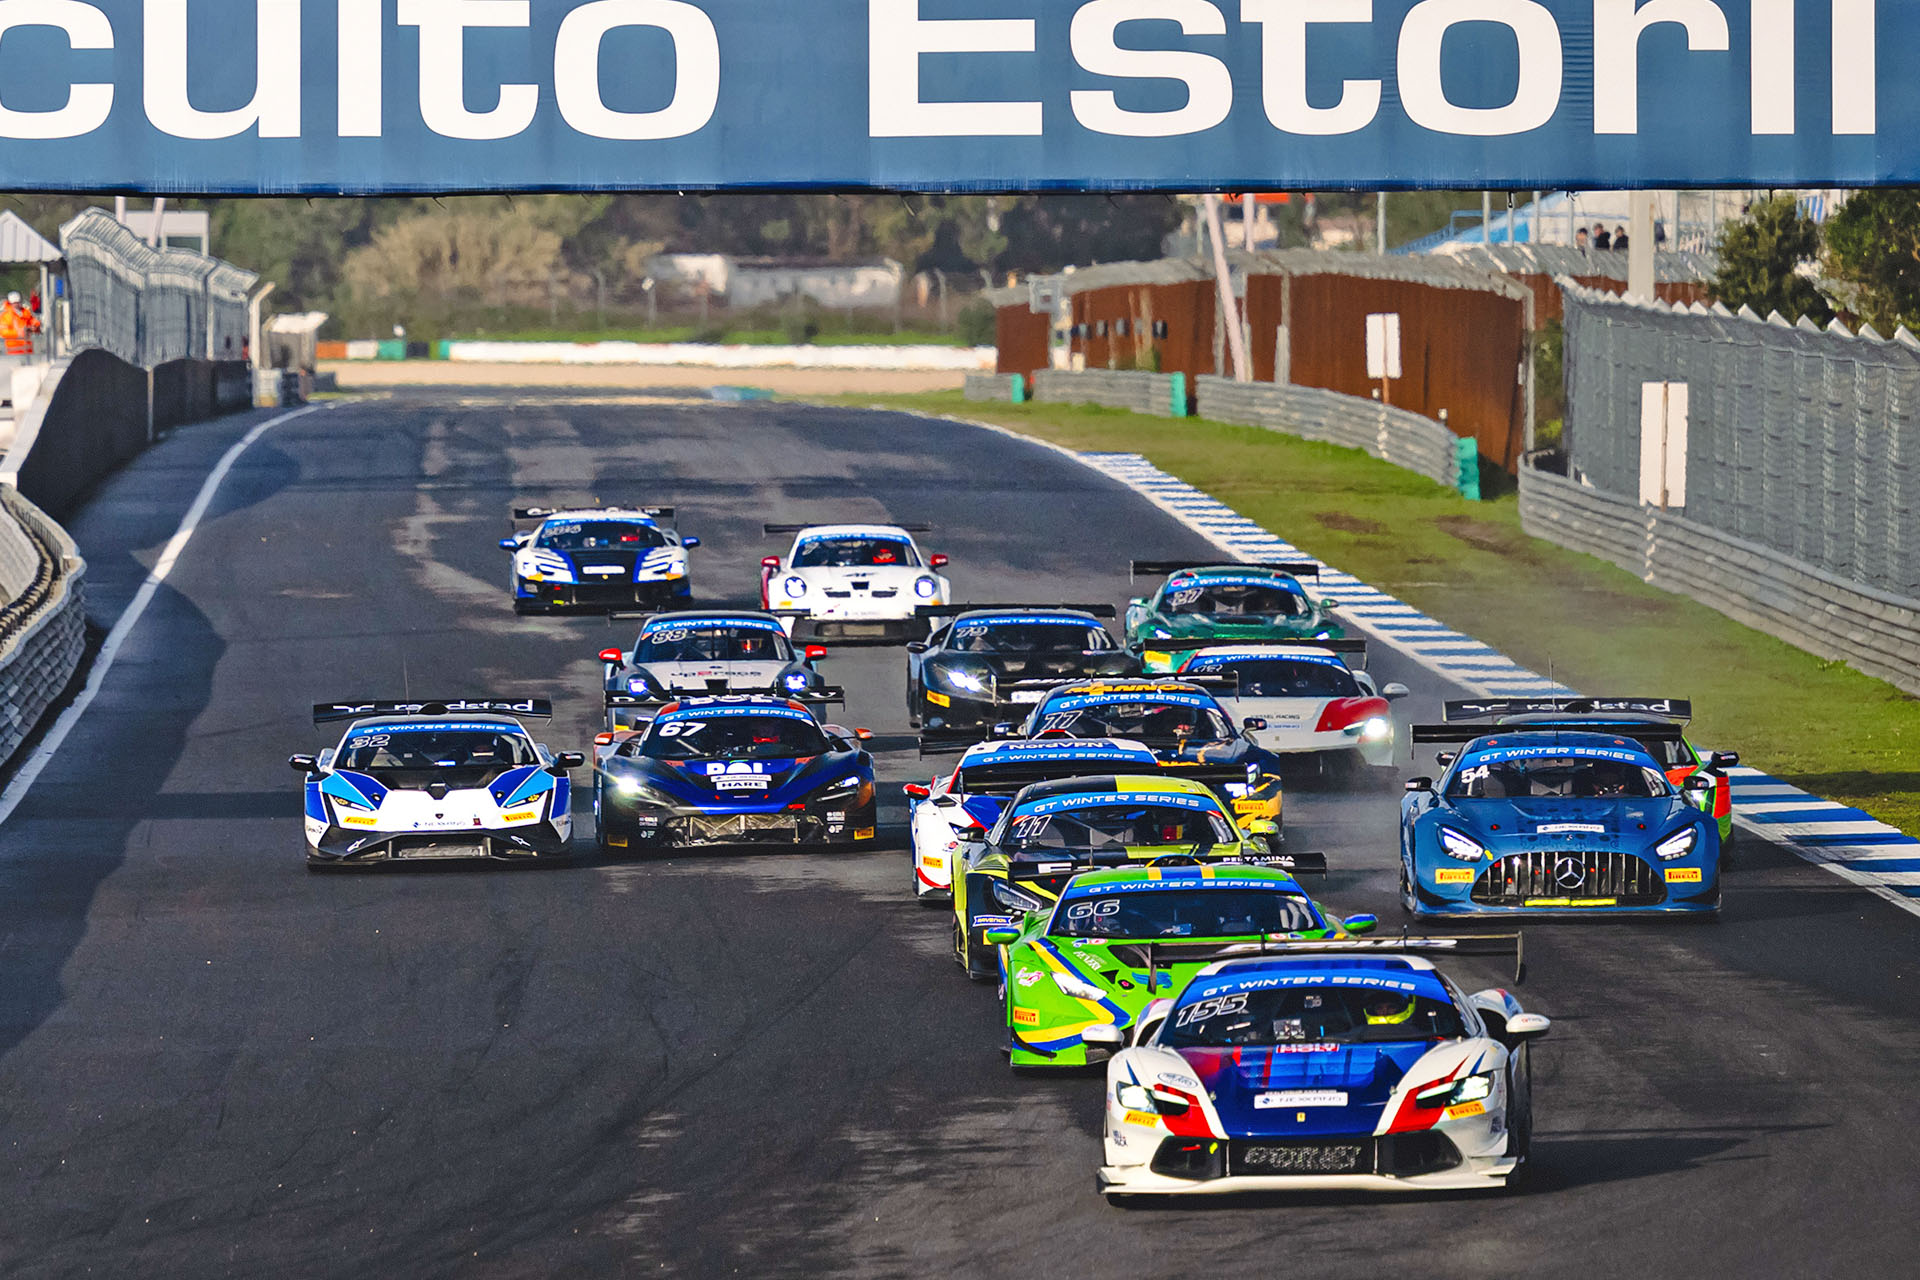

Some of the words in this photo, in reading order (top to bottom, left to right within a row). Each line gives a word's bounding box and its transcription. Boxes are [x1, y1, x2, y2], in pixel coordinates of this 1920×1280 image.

[868, 0, 1875, 137] Estoril
[653, 622, 670, 631] GT
[726, 620, 772, 629] SERIES
[652, 628, 688, 644] 88
[1064, 683, 1196, 695] MANNOL
[394, 700, 533, 713] radstad
[1060, 699, 1079, 709] GT
[1084, 693, 1141, 704] WINTER
[1145, 694, 1200, 706] SERIES
[1526, 699, 1671, 712] radstad
[664, 713, 685, 722] GT
[688, 708, 745, 717] WINTER
[750, 709, 804, 719] SERIES
[658, 721, 707, 737] 67
[1009, 742, 1103, 750] NordVPN
[982, 755, 1004, 763] GT
[1009, 753, 1071, 761] WINTER
[1480, 752, 1500, 763] GT
[1506, 747, 1570, 757] WINTER
[1574, 748, 1636, 761] SERIES
[1461, 764, 1489, 784] 54
[1034, 801, 1057, 813] GT
[1062, 794, 1130, 807] WINTER
[1134, 794, 1200, 807] SERIES
[1016, 814, 1052, 838] 11
[1439, 871, 1471, 881] PIRELLI
[1668, 870, 1699, 880] PIRELLI
[1088, 885, 1115, 894] GT
[1121, 880, 1197, 890] WINTER
[1202, 880, 1275, 888] SERIES
[1067, 899, 1120, 920] 66
[1203, 984, 1232, 997] GT
[1239, 976, 1325, 990] WINTER
[1331, 976, 1416, 991] SERIES
[1176, 992, 1249, 1028] 155
[1449, 1103, 1482, 1117] PIRELLI
[1126, 1111, 1159, 1127] PIRELLI
